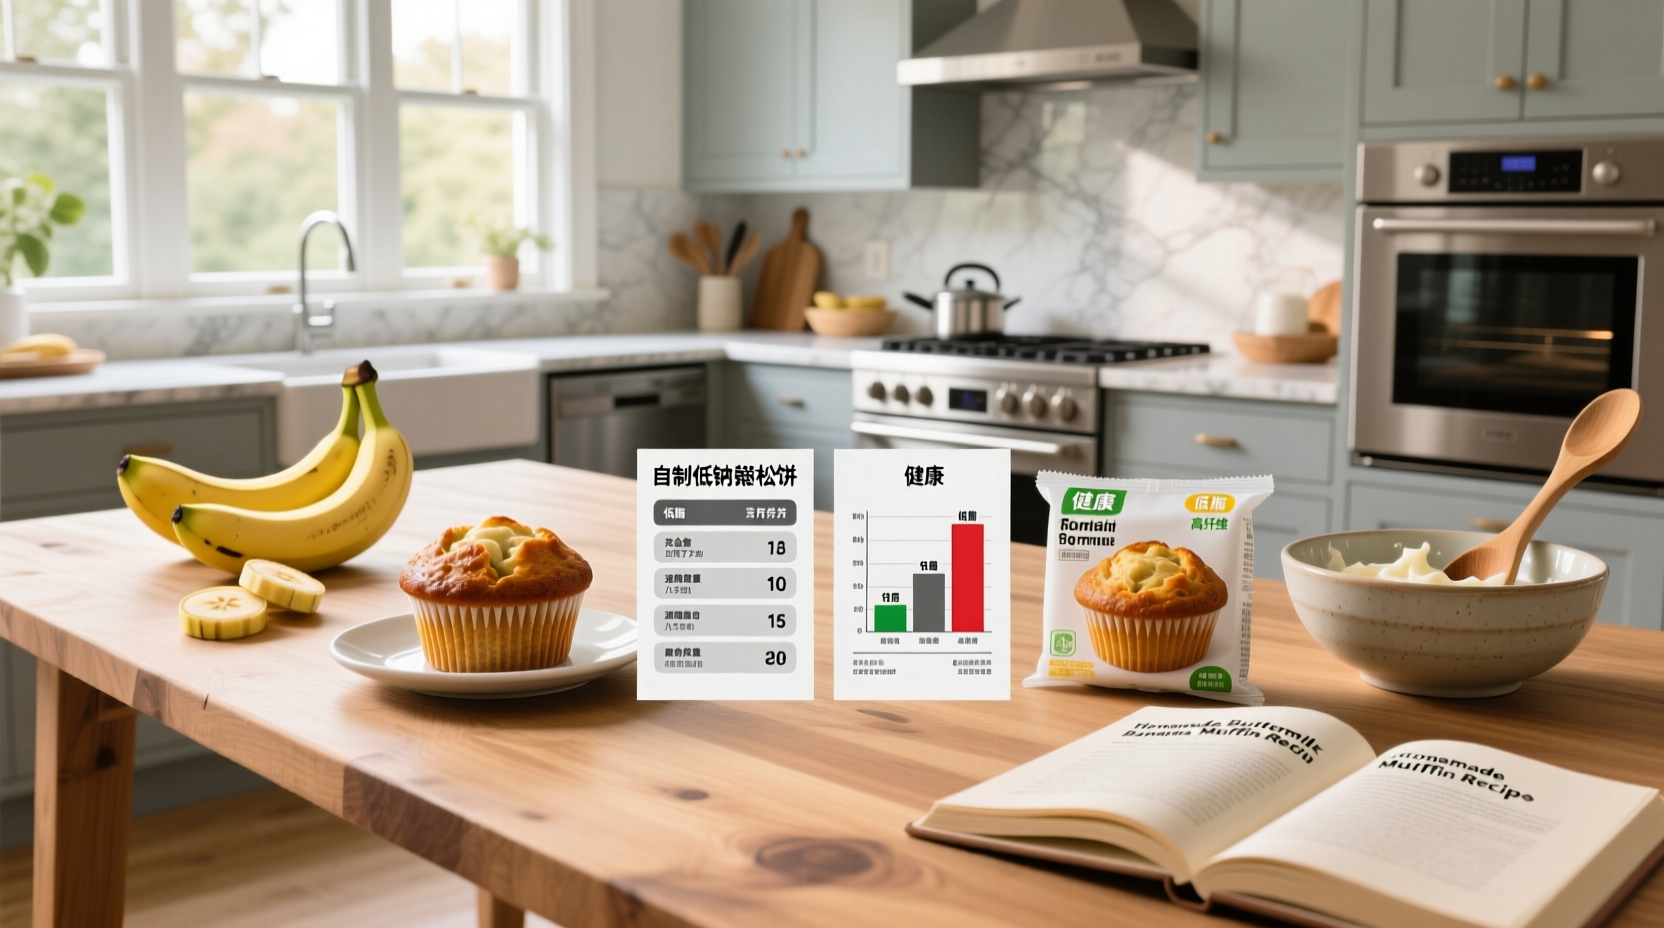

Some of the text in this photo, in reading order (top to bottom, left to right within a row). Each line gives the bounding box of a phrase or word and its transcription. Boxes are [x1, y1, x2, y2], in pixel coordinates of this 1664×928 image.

[904, 465, 945, 487] 健康
[1072, 491, 1117, 511] 健康
[767, 540, 786, 555] 18
[767, 576, 787, 592] 10
[767, 613, 786, 629] 15
[765, 650, 787, 666] 20
